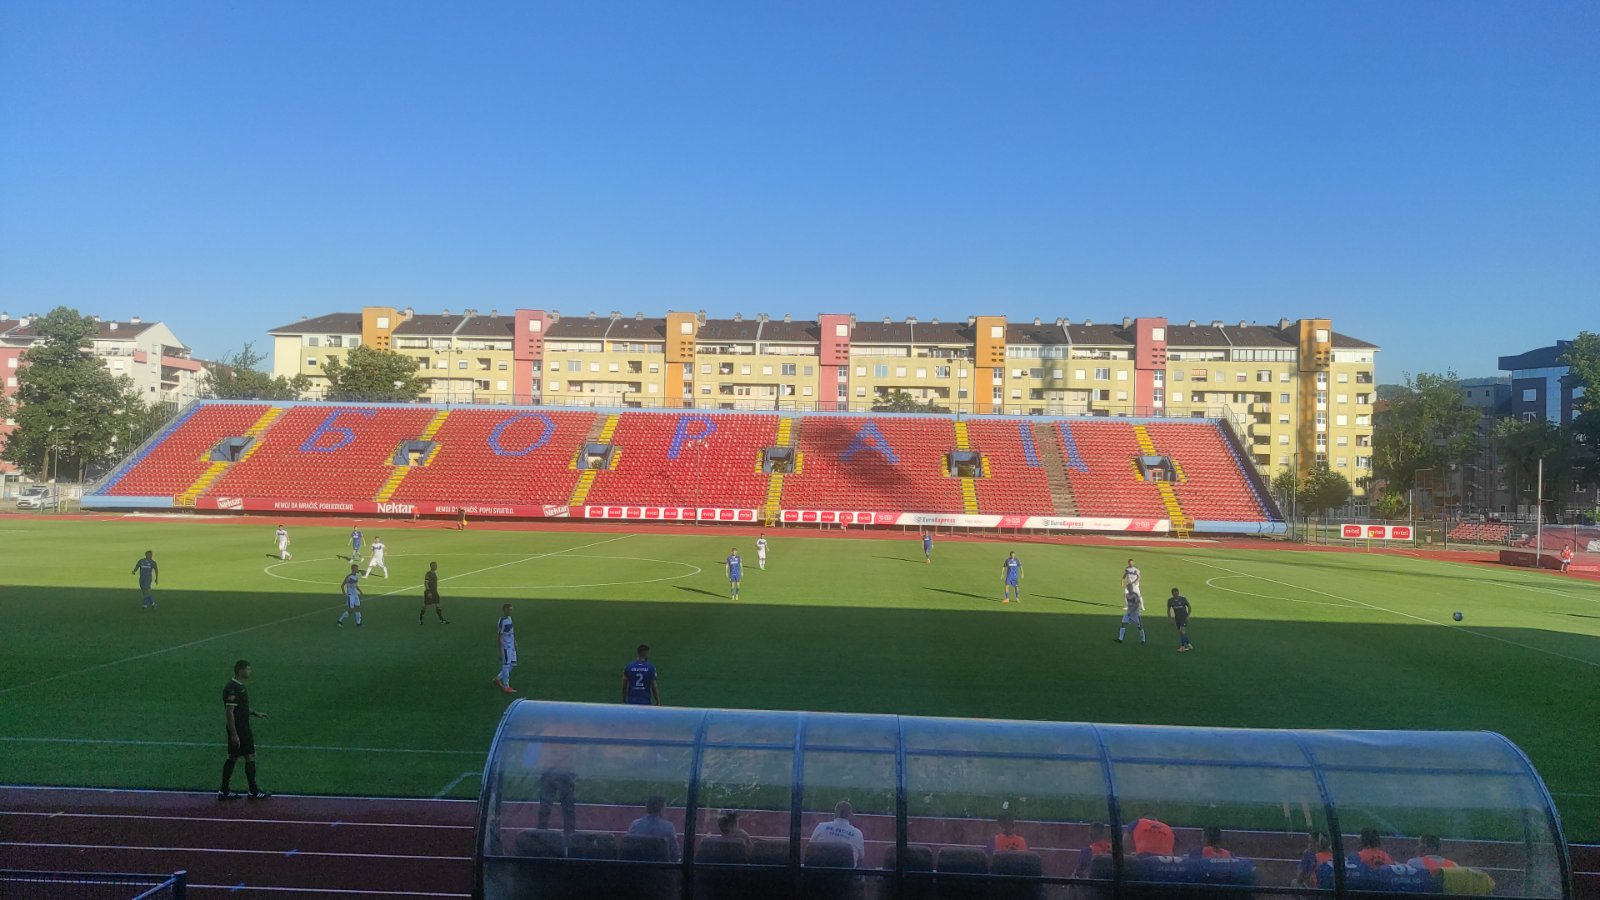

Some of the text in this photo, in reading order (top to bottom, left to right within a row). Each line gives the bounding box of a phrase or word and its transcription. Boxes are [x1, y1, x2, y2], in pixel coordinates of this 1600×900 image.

[218, 498, 242, 509] Nektar
[376, 502, 415, 514] Nektar
[543, 505, 569, 517] Nektar
[922, 516, 956, 525] EuroExpress
[1050, 519, 1084, 527] EuroExpress
[636, 673, 644, 686] 2
